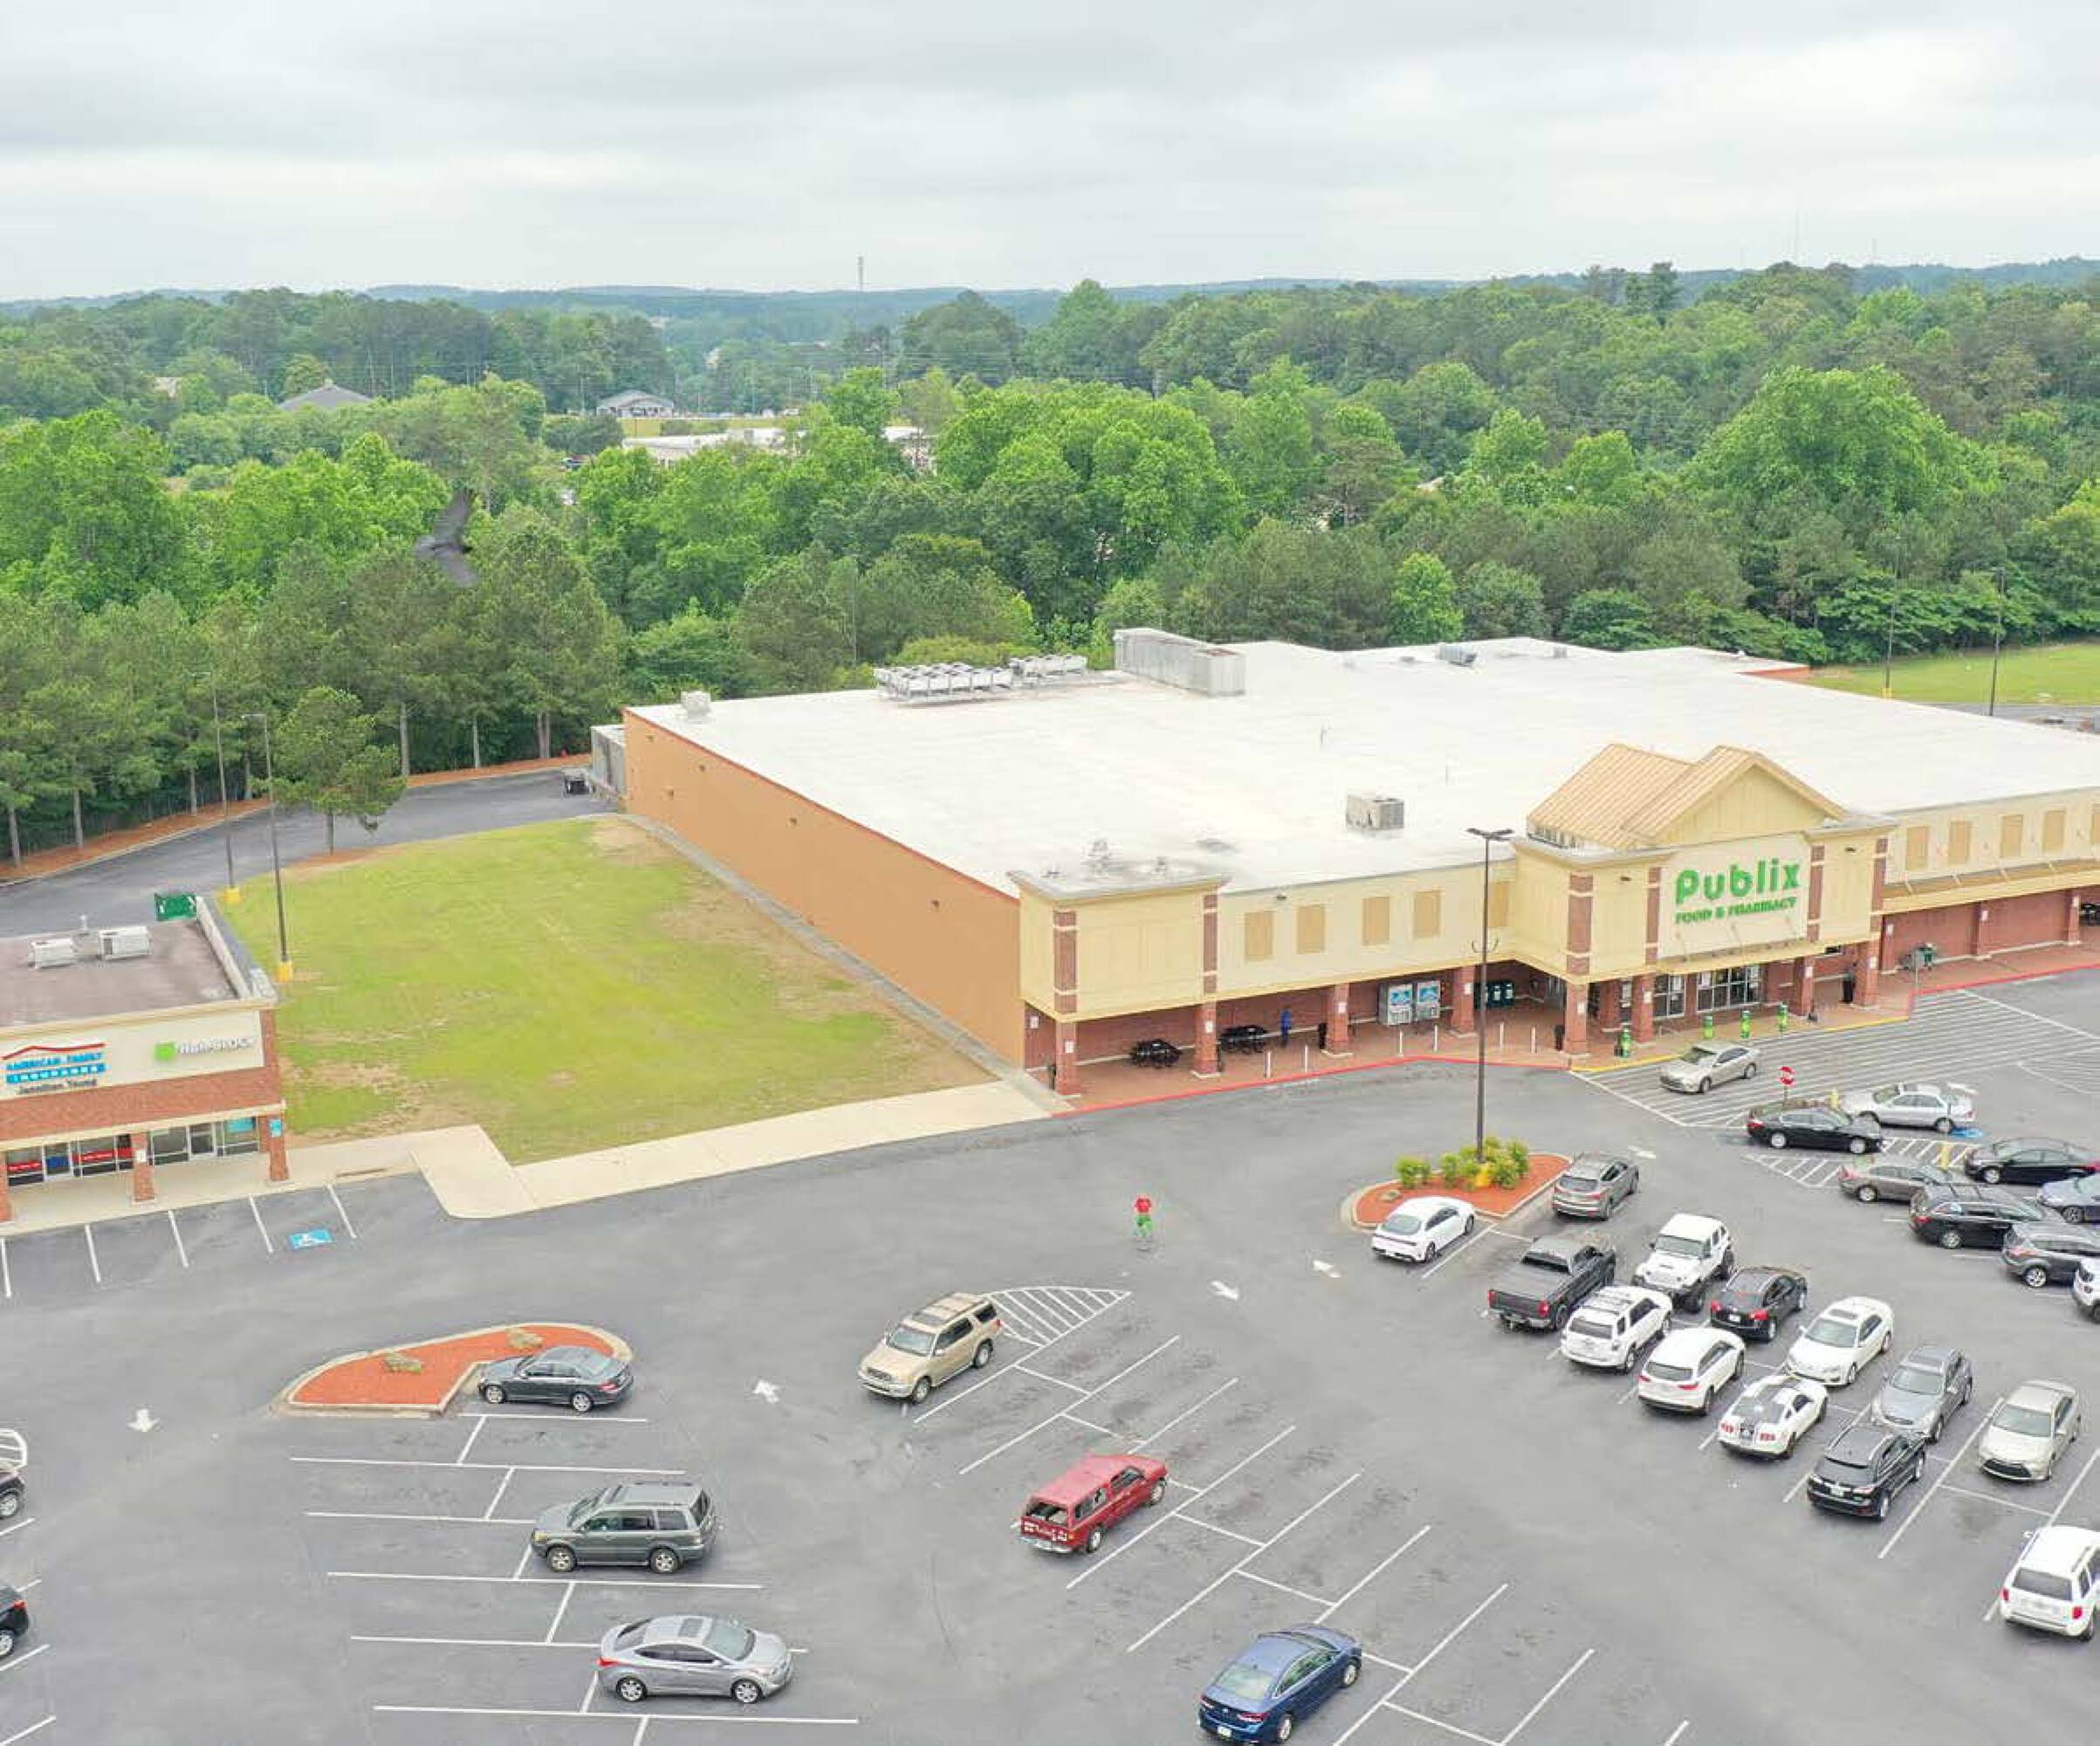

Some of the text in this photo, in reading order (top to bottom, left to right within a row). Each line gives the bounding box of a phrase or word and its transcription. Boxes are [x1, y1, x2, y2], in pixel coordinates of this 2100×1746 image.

[1675, 857, 1801, 905] Publix
[1675, 909, 1712, 924] FOOD
[1728, 896, 1797, 916] PHARMACY
